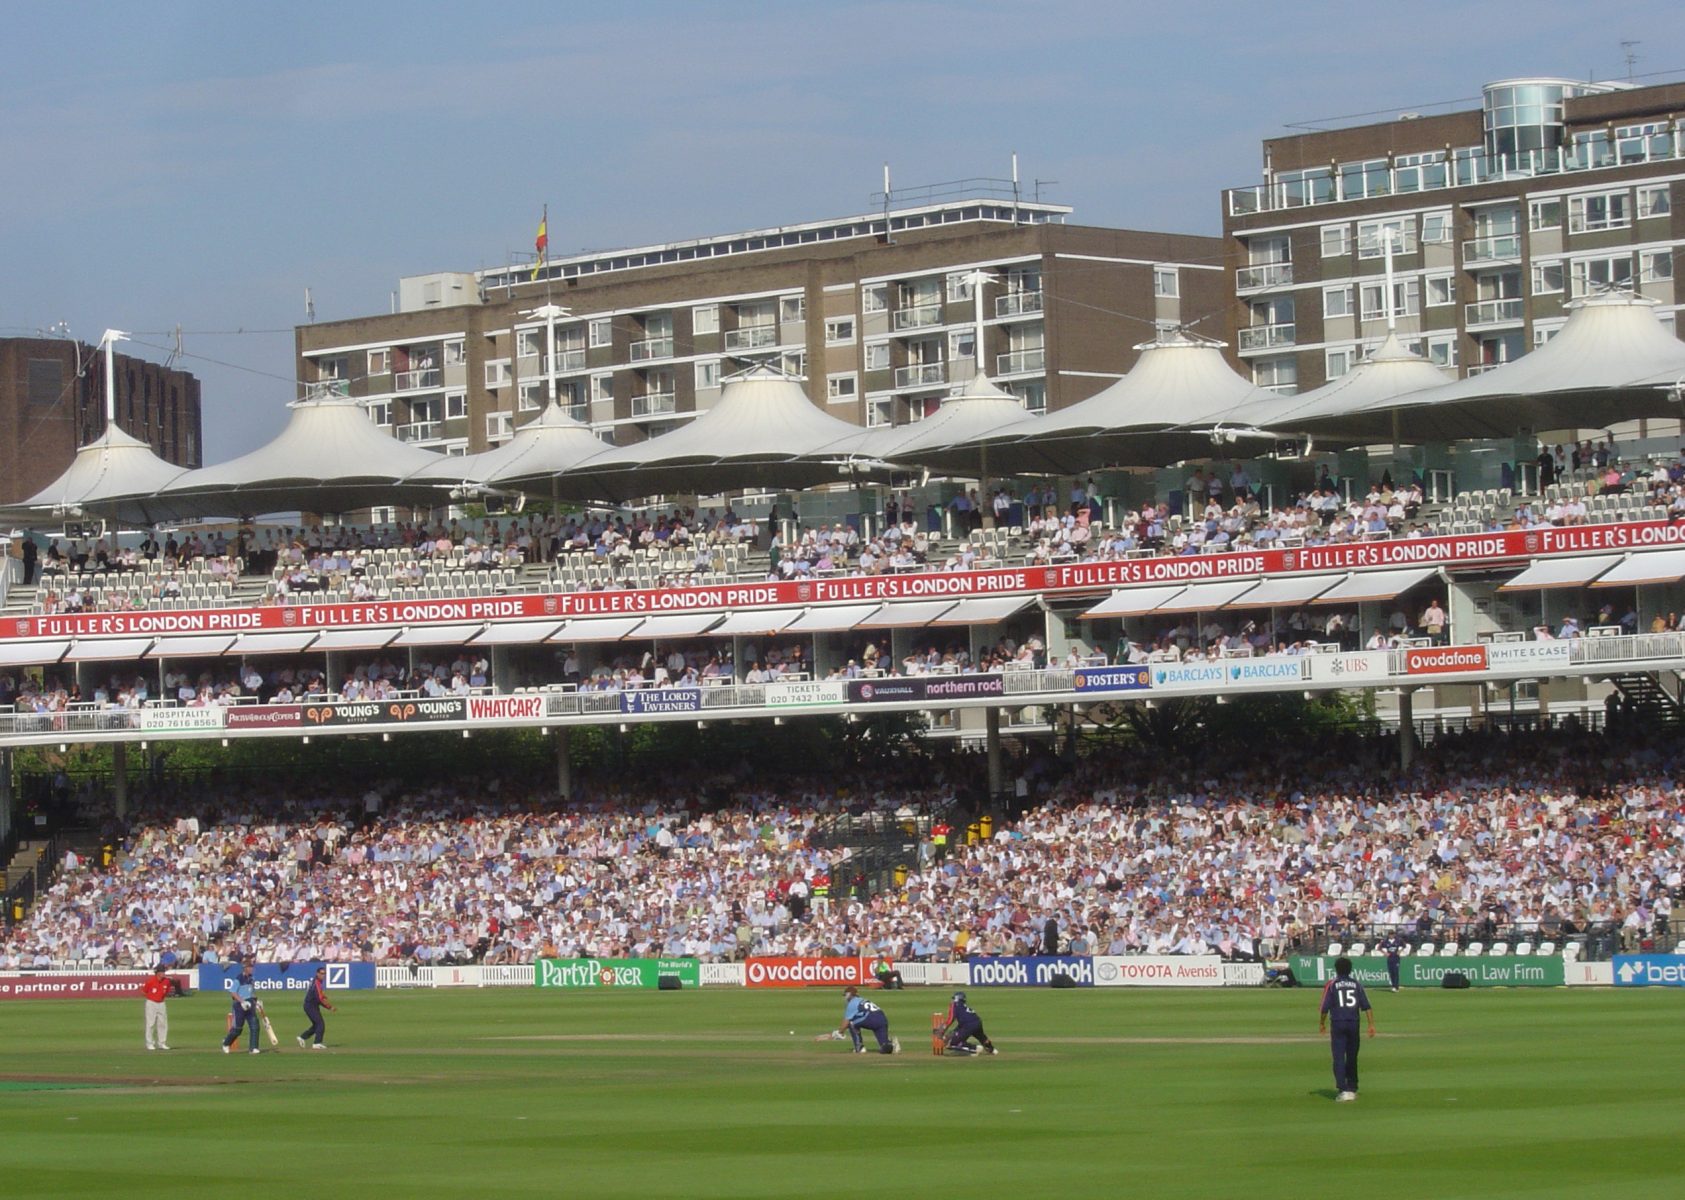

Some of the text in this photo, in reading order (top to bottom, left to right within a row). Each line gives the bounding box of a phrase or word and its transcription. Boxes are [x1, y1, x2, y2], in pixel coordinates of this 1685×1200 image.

[1543, 526, 1627, 550] FULLER'S
[1300, 538, 1506, 569] FULLER'S LONDON PRIDE
[1062, 556, 1265, 585] FULLER'S LONDON PRIDE
[816, 573, 1026, 600] FULLER'S LONDON PRIDE
[562, 587, 778, 614] FULLER'S LONDON PRIDE
[302, 600, 524, 625] FULLER'S LONDON PRIDE
[37, 611, 262, 635] FULLER'S LONDON PRIDE
[1422, 652, 1482, 667] vodafone
[1491, 646, 1567, 659] WHITE & CASE
[1243, 663, 1298, 678] BARCLAYS
[1345, 658, 1368, 673] UBS
[1086, 672, 1136, 687] FOSTER'S
[1168, 667, 1222, 682] BARCLAYS
[786, 684, 821, 694] TICKETS
[926, 678, 1003, 694] northern rock
[639, 690, 697, 702] THE LORD'S
[771, 693, 838, 703] 020 7432 1000
[153, 710, 211, 719] HOSPITALITY
[335, 704, 380, 717] YOUNG'S
[417, 700, 462, 714] YOUNG'S
[641, 701, 696, 713] TAVERNERS
[194, 719, 217, 727] 8565
[766, 960, 857, 981] vodafone
[1300, 958, 1312, 968] TW
[974, 960, 1028, 983] nobok
[1120, 964, 1218, 978] TOYOTA Avensis
[1482, 963, 1511, 980] Law
[1515, 962, 1545, 981] Firm
[15, 982, 66, 994] partner
[70, 981, 85, 992] of
[224, 977, 314, 989] Dsche Ban
[1337, 989, 1357, 1008] 15
